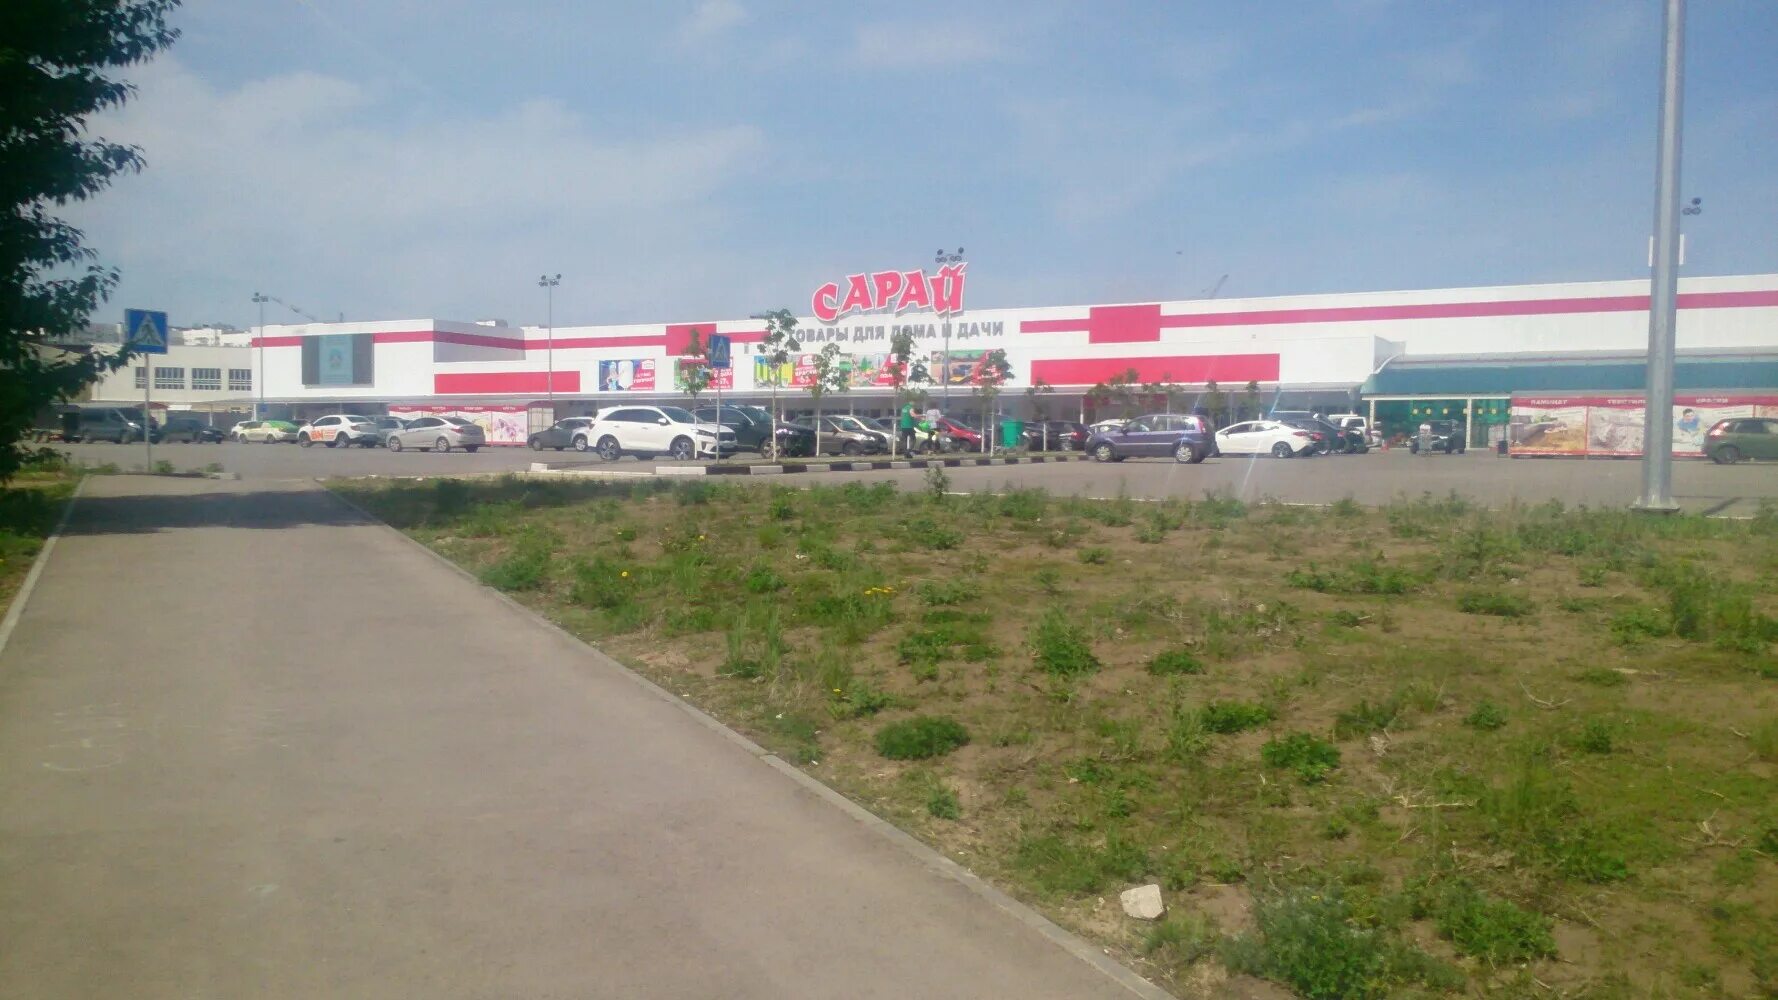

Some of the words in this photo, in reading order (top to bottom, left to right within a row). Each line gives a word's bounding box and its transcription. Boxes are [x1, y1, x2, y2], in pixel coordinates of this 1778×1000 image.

[812, 262, 967, 321] САРАЙ
[853, 325, 884, 343] ДЛЯ
[942, 323, 952, 338] И
[957, 321, 1004, 339] ДАЧИ
